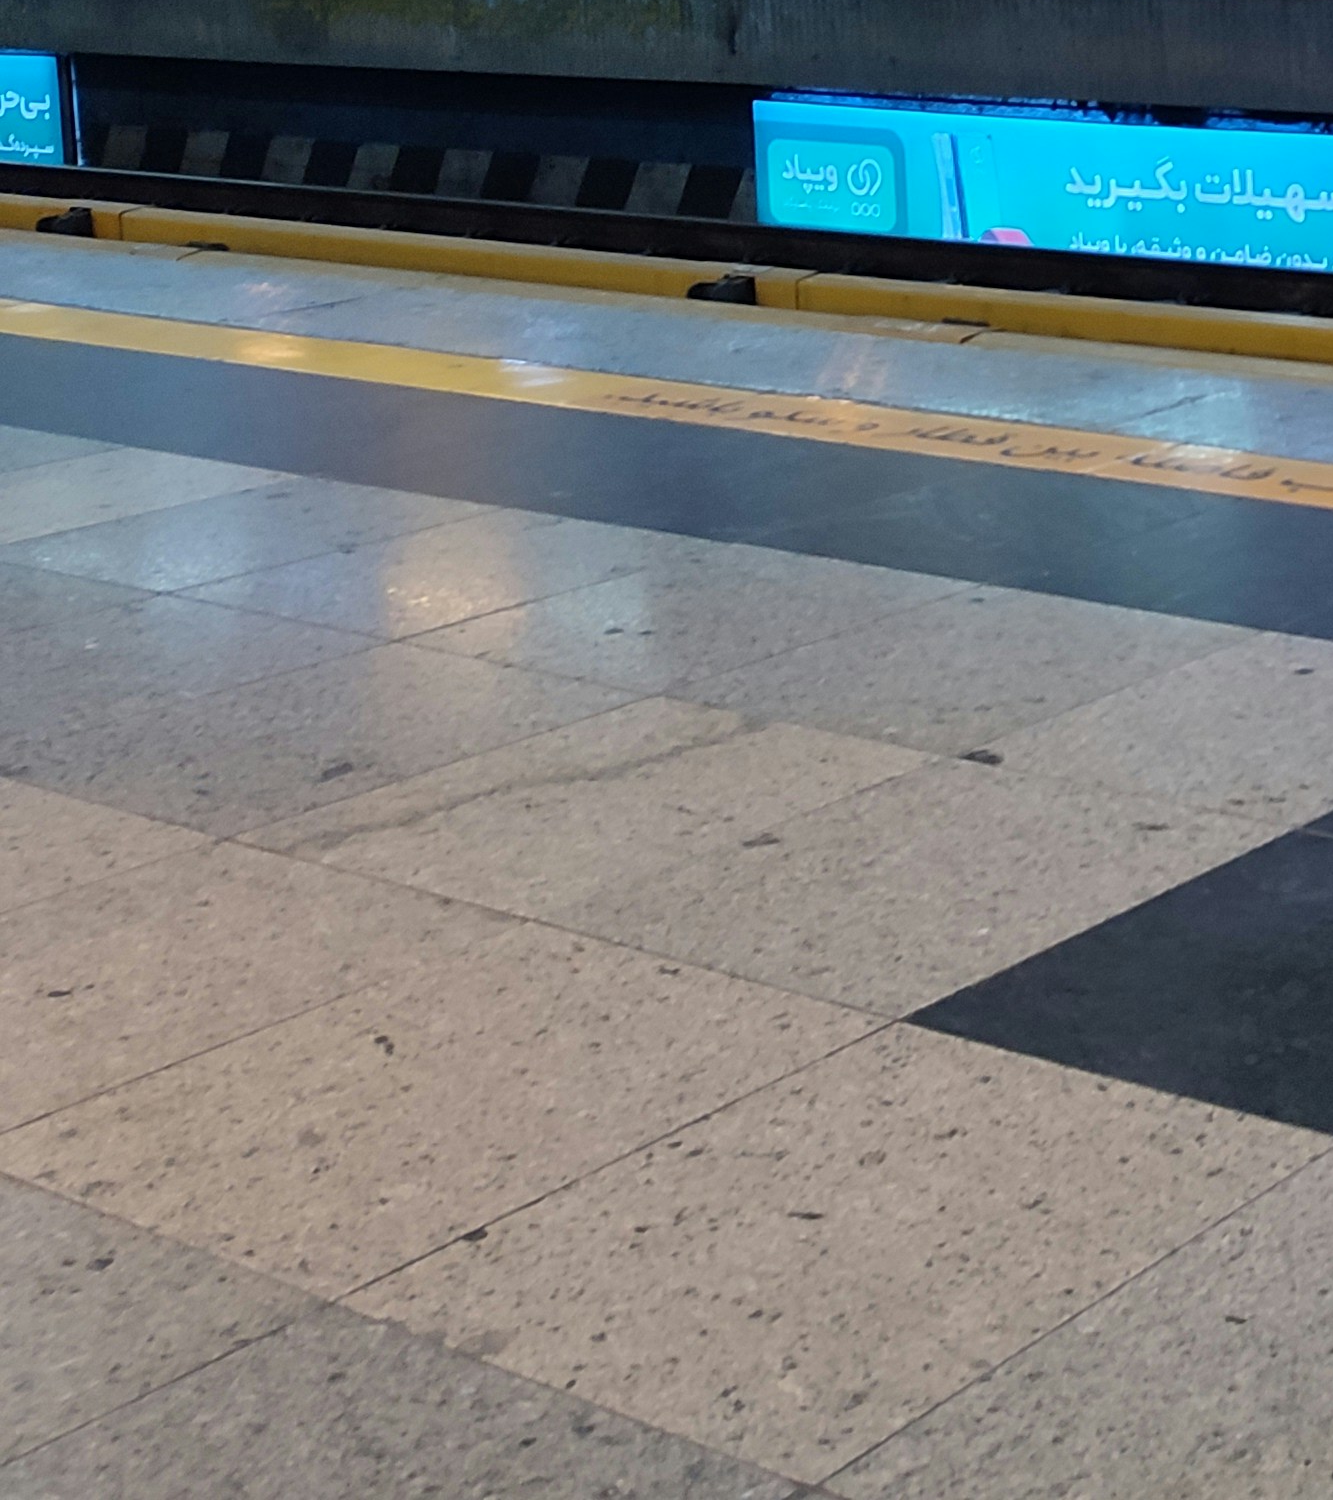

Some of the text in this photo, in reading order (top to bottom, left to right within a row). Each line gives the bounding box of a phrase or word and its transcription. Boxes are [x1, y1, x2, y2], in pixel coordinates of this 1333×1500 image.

[782, 153, 838, 195] ویپاد
[1065, 155, 1188, 214] بگیرید
[1001, 444, 1100, 462] بین
